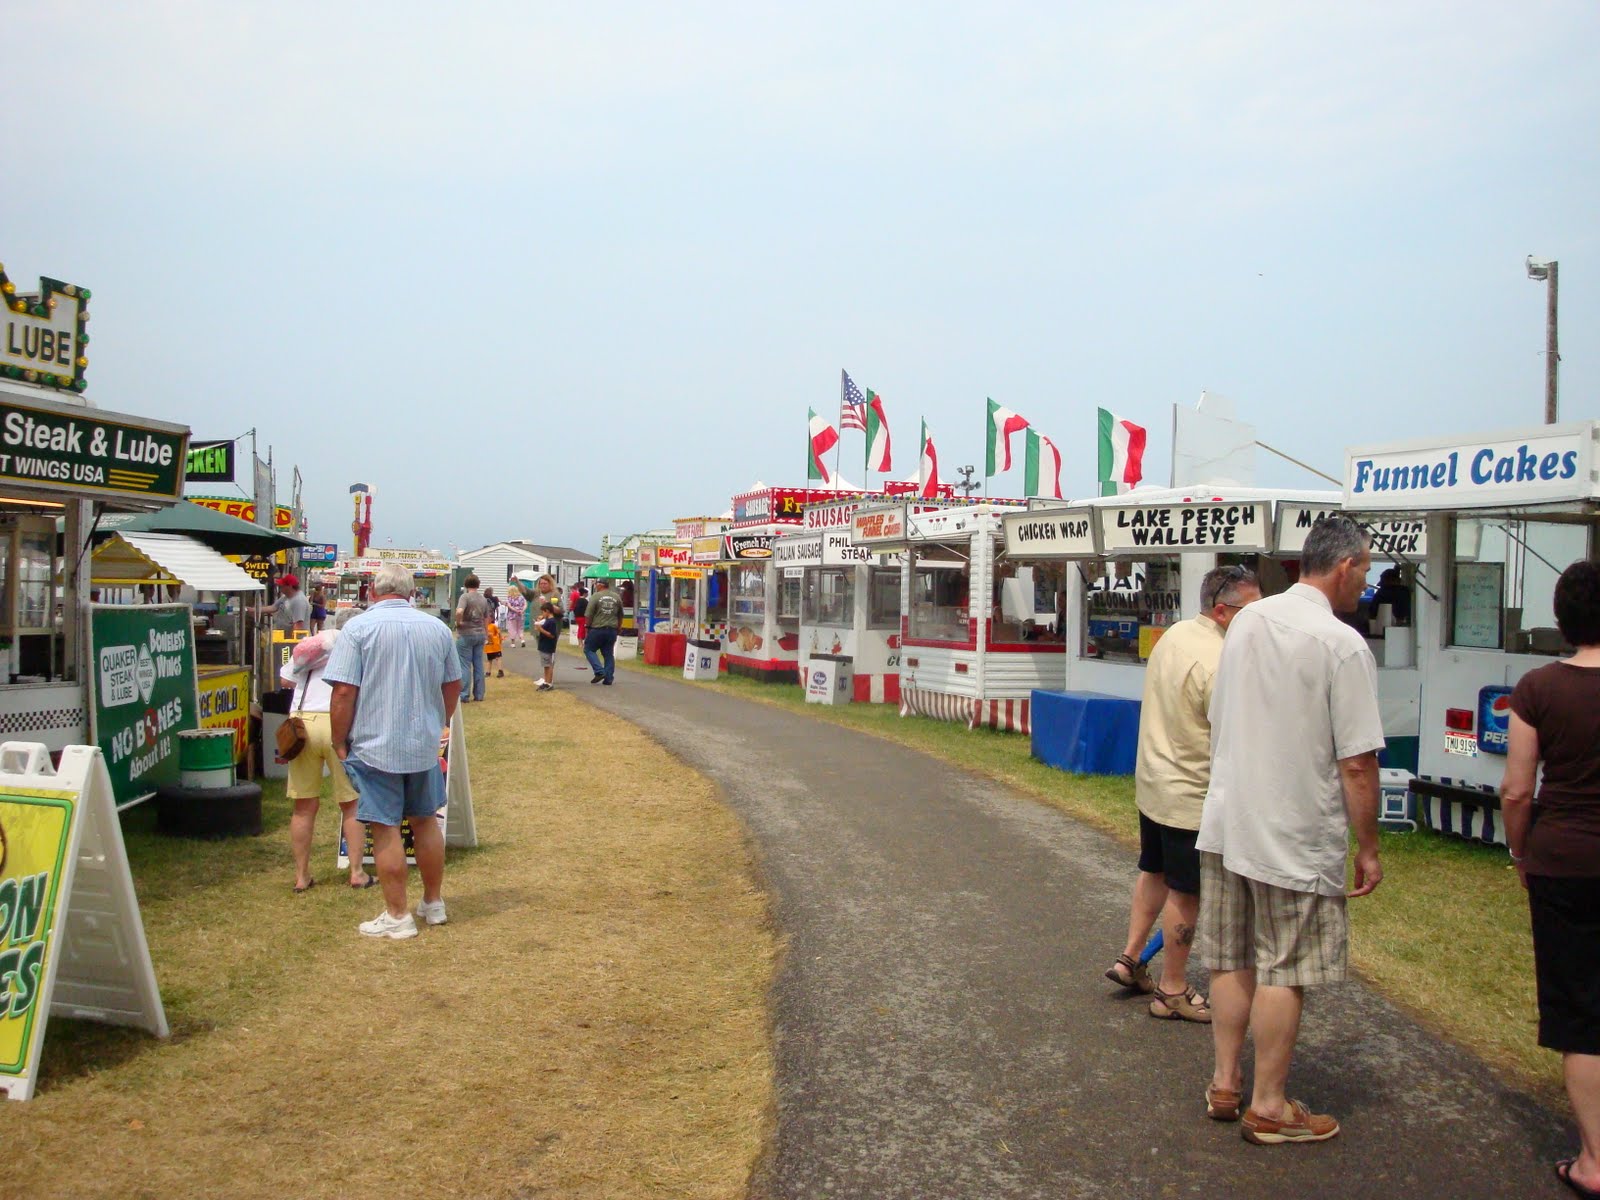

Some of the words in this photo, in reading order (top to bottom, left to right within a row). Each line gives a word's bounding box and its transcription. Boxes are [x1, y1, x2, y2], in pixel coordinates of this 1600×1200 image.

[8, 321, 71, 367] LUBE
[3, 411, 82, 453] Steak
[90, 427, 108, 457] &
[115, 429, 173, 466] Lube
[15, 456, 71, 478] WINGS
[74, 465, 104, 484] USA
[185, 447, 227, 474] CKEN
[1352, 451, 1459, 493] Funnel
[1470, 444, 1578, 486] Cakes
[808, 504, 859, 529] SAUSAG
[1117, 509, 1171, 528] LAKE
[1181, 505, 1255, 527] PERCH
[1018, 522, 1057, 542] CHICKEN
[1061, 520, 1089, 538] WRAP
[1132, 526, 1236, 546] WALLEYE
[659, 547, 674, 558] BIG
[734, 537, 760, 552] French
[760, 537, 772, 549] Fri
[775, 545, 796, 562] ITALIAN
[797, 542, 821, 560] SAUSAGE
[829, 536, 855, 548] PHIL
[673, 550, 688, 564] FAT
[841, 548, 873, 560] STEAK
[245, 561, 270, 570] SWEET
[246, 570, 268, 578] TEA
[102, 649, 136, 673] QUAKER
[110, 668, 134, 688] STEAK
[117, 686, 133, 701] LUBE
[199, 690, 213, 718] CE
[215, 684, 238, 715] COLD
[112, 726, 133, 764] NO
[1446, 736, 1459, 750] TMU
[1483, 731, 1509, 744] PEP
[0, 871, 49, 946] ON
[0, 940, 46, 1020] ES
